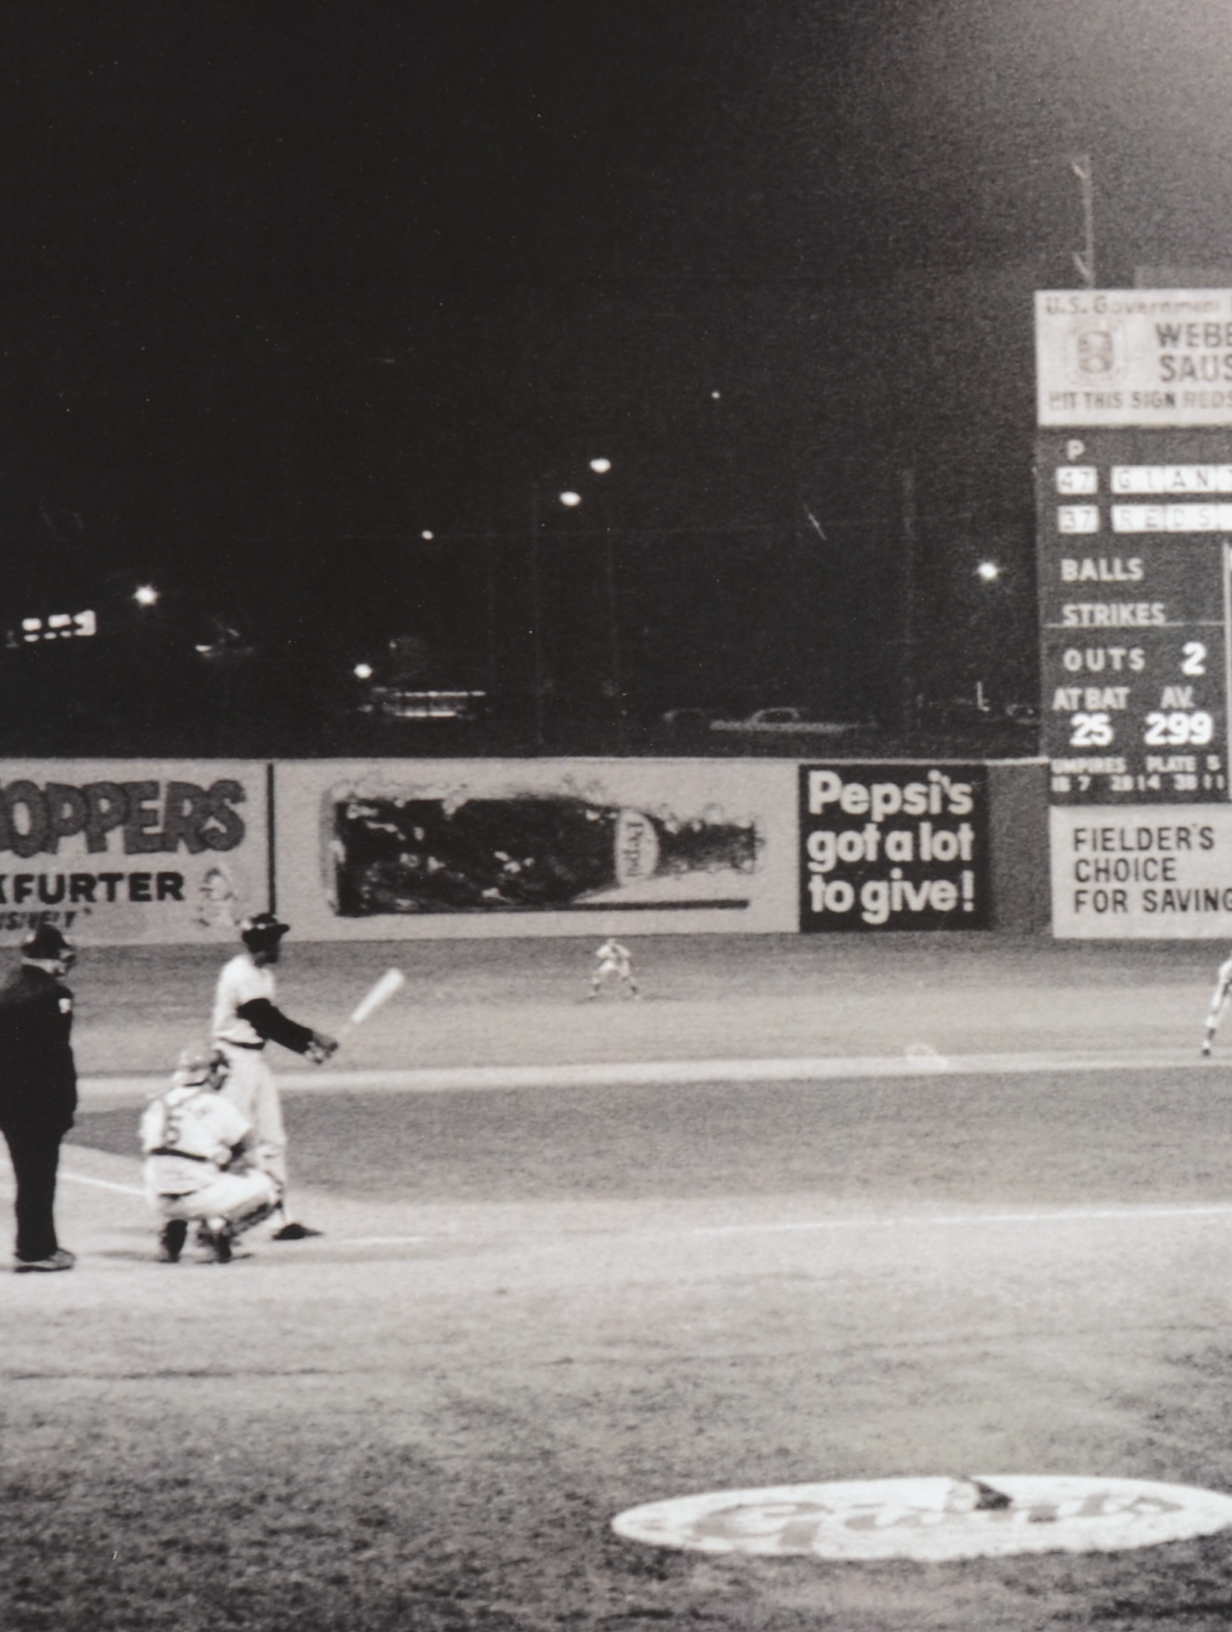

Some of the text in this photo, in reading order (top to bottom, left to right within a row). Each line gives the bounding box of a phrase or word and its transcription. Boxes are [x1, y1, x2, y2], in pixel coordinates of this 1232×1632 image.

[1084, 391, 1122, 409] THIS
[1130, 391, 1177, 408] SIGN
[1067, 440, 1086, 460] P
[1059, 469, 1092, 490] 47
[1061, 509, 1092, 529] 37
[1119, 508, 1209, 529] REDS
[1061, 557, 1144, 583] BALLS
[1062, 602, 1166, 626] STRIKES
[1062, 641, 1207, 676] OUTS 2
[1052, 688, 1083, 712] AT
[1085, 686, 1131, 710] BAT
[1068, 711, 1215, 747] 25 299
[1051, 757, 1127, 774] UMPIRES
[1145, 755, 1197, 773] PLATE
[807, 769, 974, 823] Pepsi's
[1078, 775, 1092, 792] 7
[0, 779, 246, 857] OPPERS
[806, 822, 975, 873] got a lot
[1072, 822, 1215, 851] FIELDER'S
[1074, 856, 1176, 883] CHOICE
[808, 867, 975, 925] to give!
[1074, 888, 1128, 914] FOR
